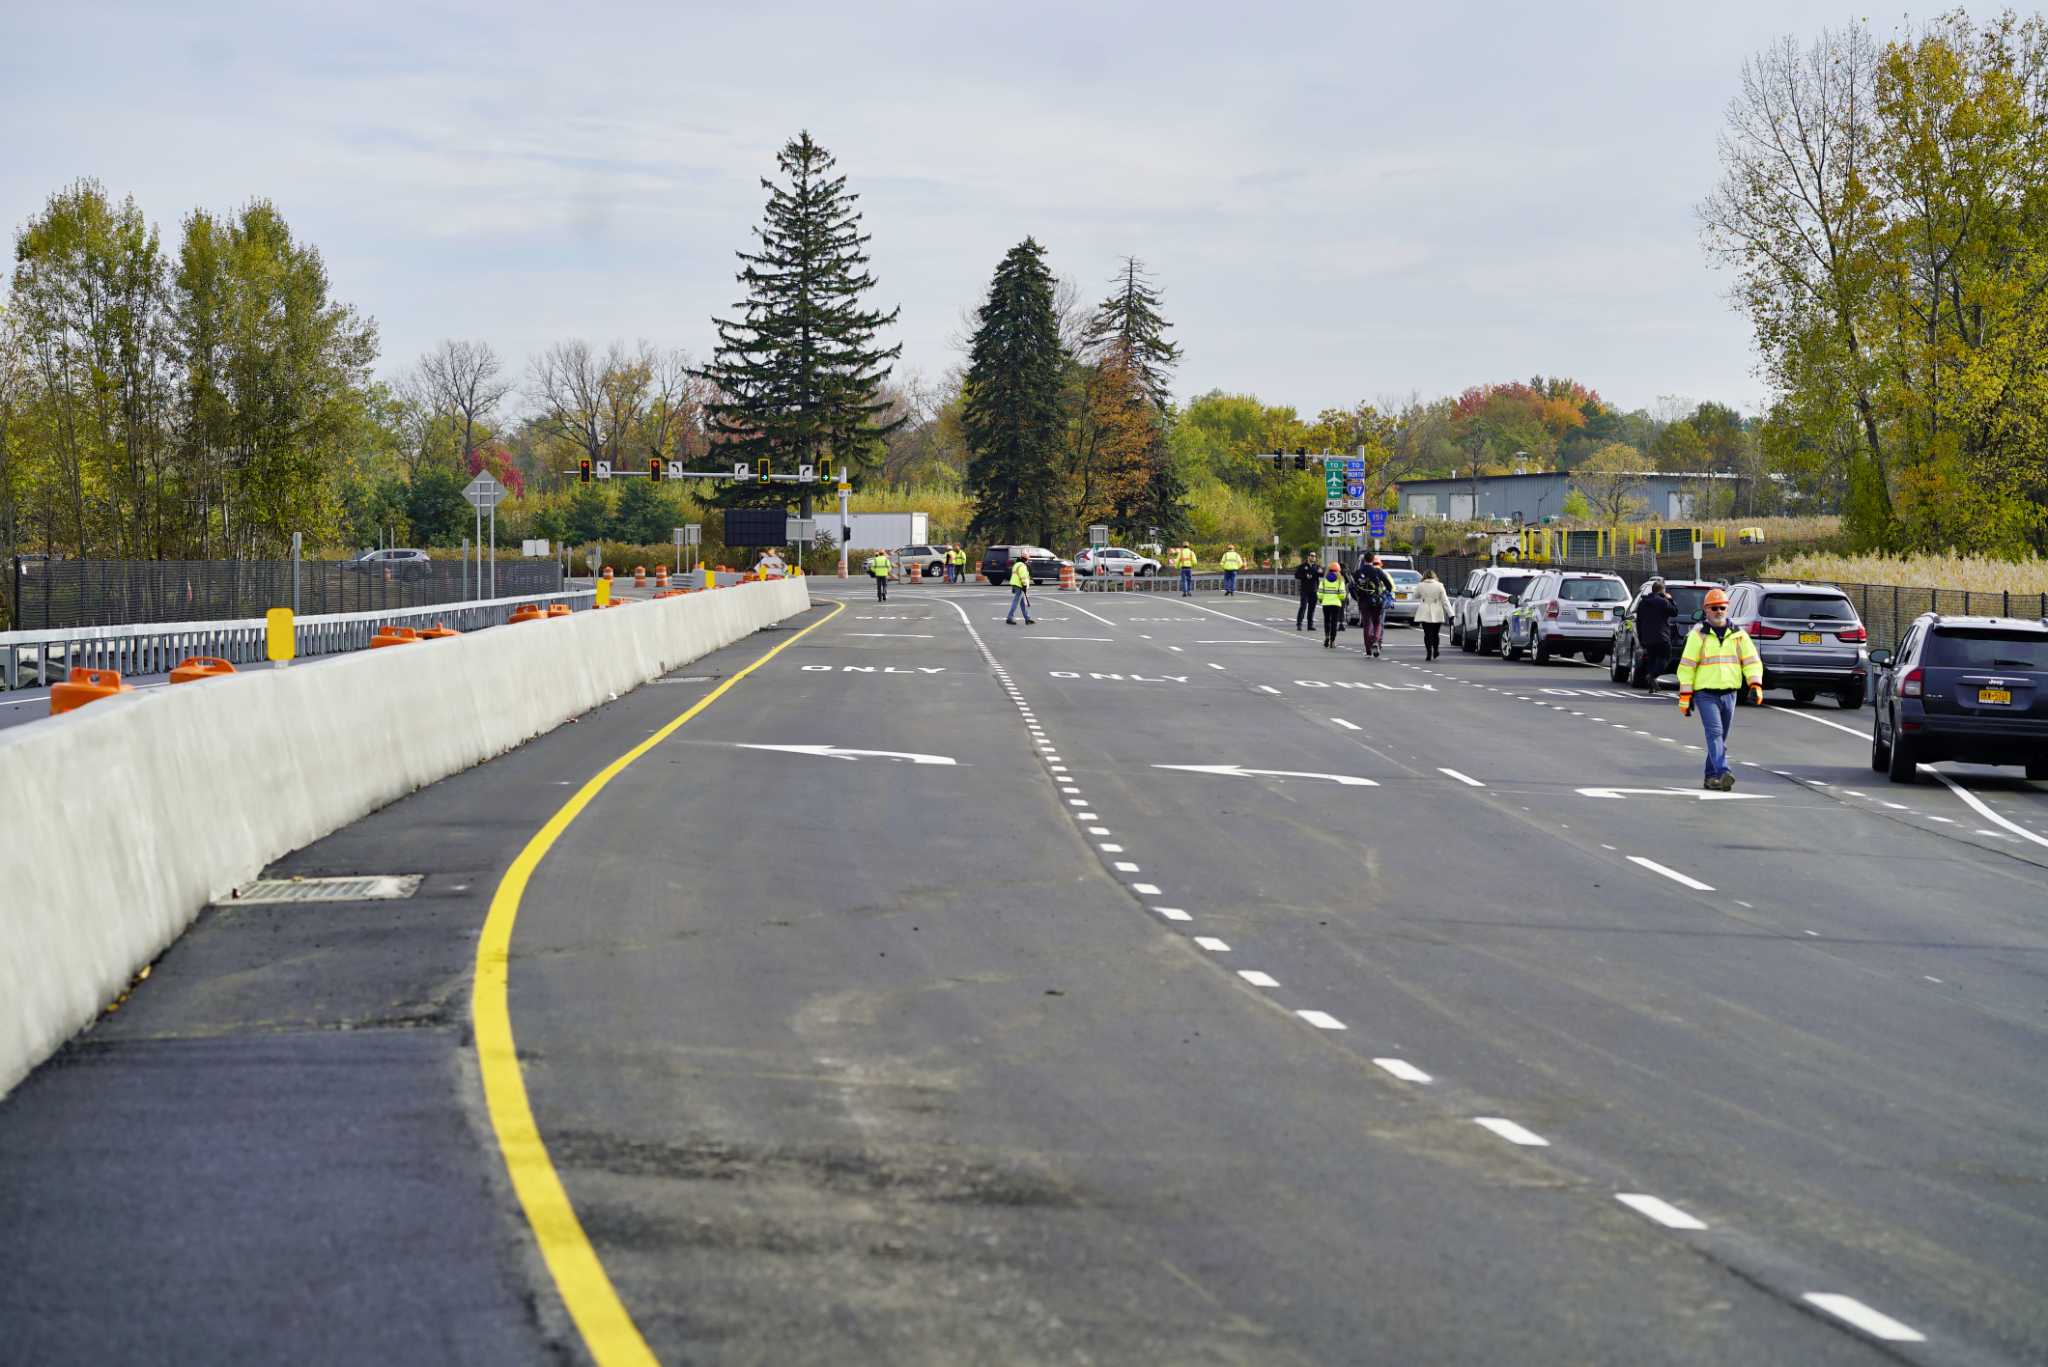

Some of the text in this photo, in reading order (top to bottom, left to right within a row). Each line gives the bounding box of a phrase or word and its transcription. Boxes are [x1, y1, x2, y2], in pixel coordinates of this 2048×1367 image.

[1325, 513, 1344, 522] 155
[1347, 513, 1365, 522] 155
[801, 665, 948, 673] ONLY
[1049, 671, 1188, 682] ONLY
[1294, 680, 1438, 691] ONLY
